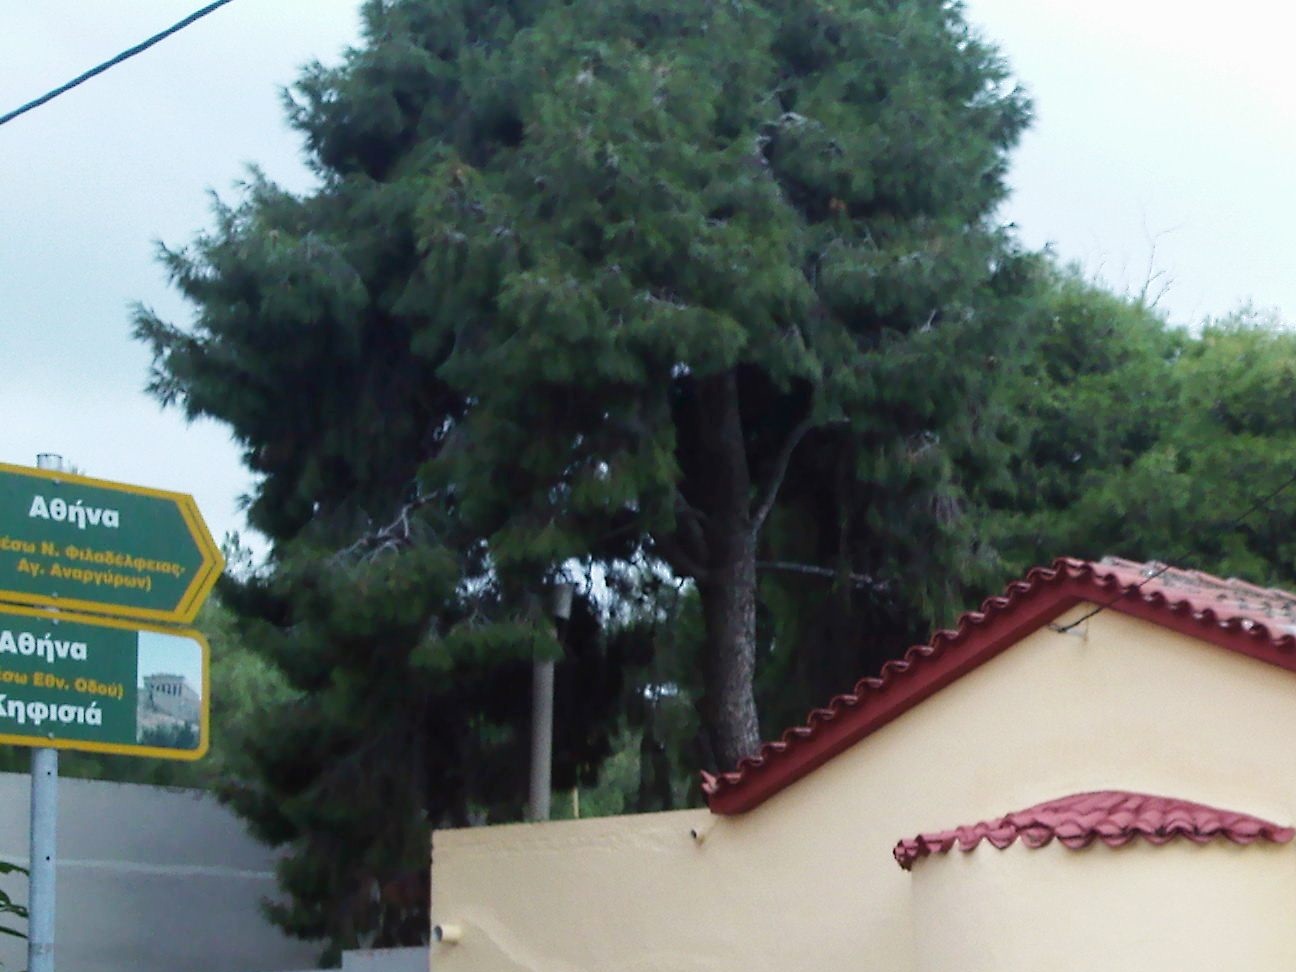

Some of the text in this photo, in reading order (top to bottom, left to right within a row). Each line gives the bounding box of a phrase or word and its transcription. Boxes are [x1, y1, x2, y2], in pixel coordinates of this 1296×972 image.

[29, 495, 120, 529] Αθήνα
[17, 557, 45, 578] Αγ.
[0, 630, 88, 663] Αθήνα
